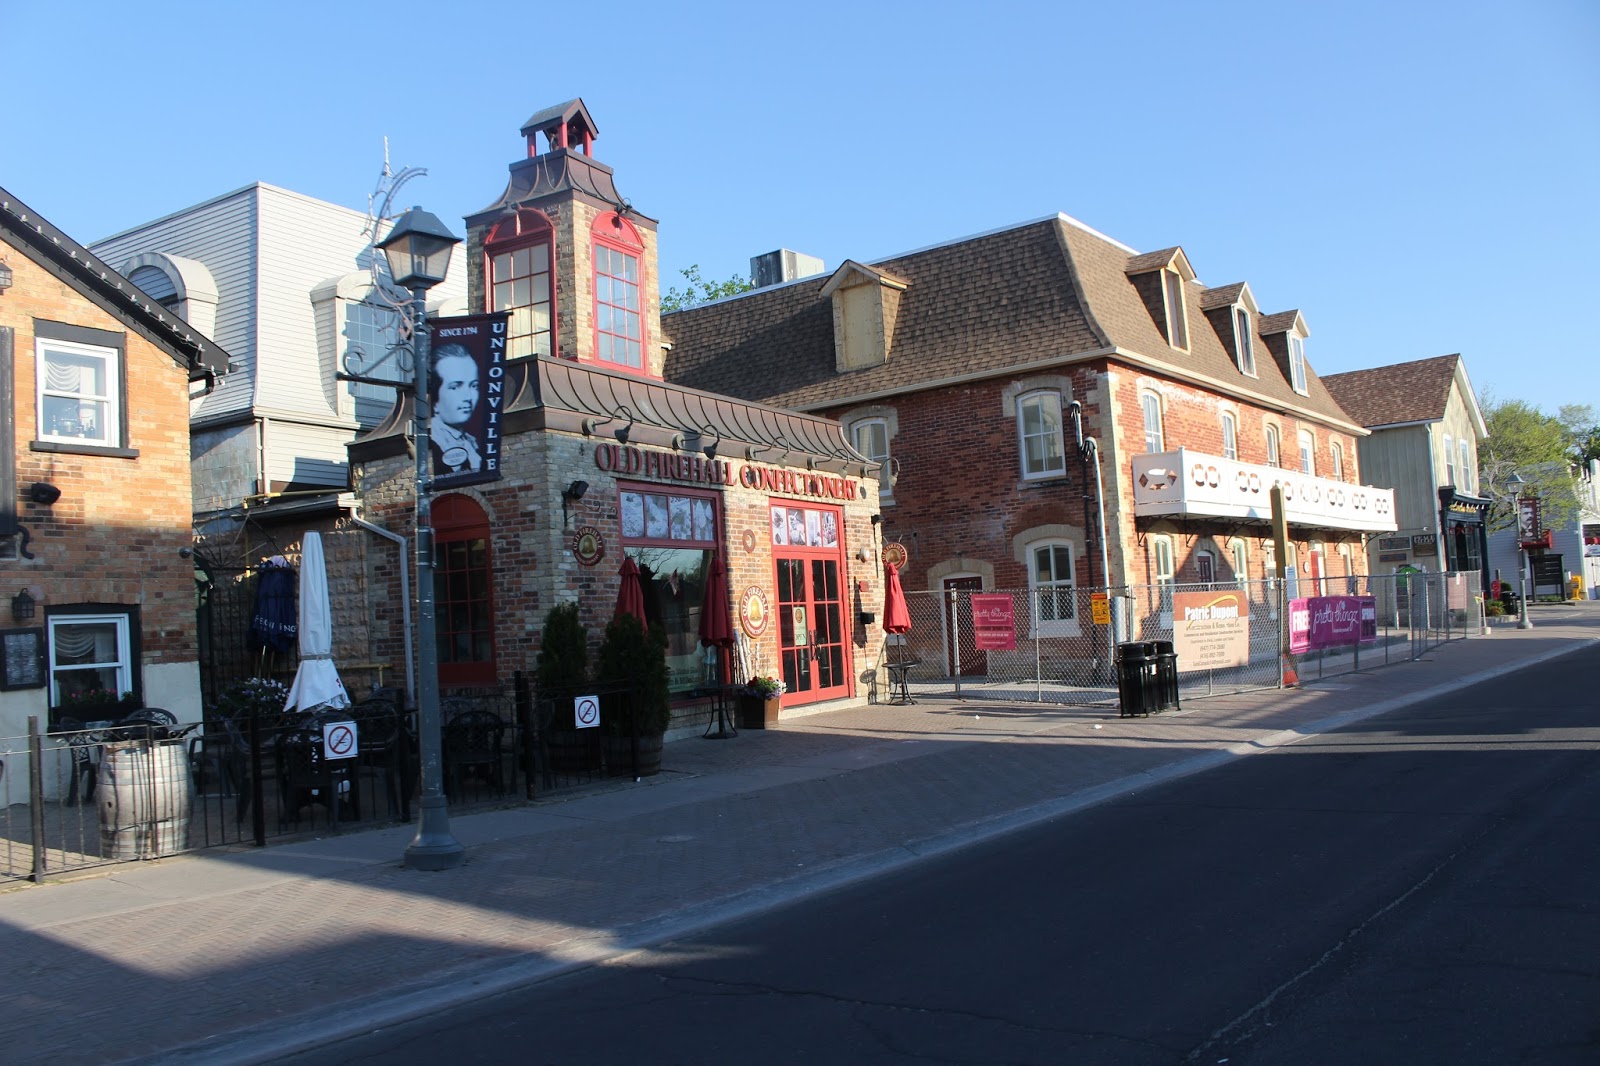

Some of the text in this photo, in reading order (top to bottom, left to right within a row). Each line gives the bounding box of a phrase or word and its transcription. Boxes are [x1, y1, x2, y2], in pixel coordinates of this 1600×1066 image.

[439, 326, 478, 337] SINCE 1794
[487, 322, 506, 471] UNIONVILLE
[595, 443, 858, 501] OLD FIREHALL CONFECTIONERY
[1185, 605, 1239, 621] Patric Dupont
[1292, 610, 1310, 632] FREE
